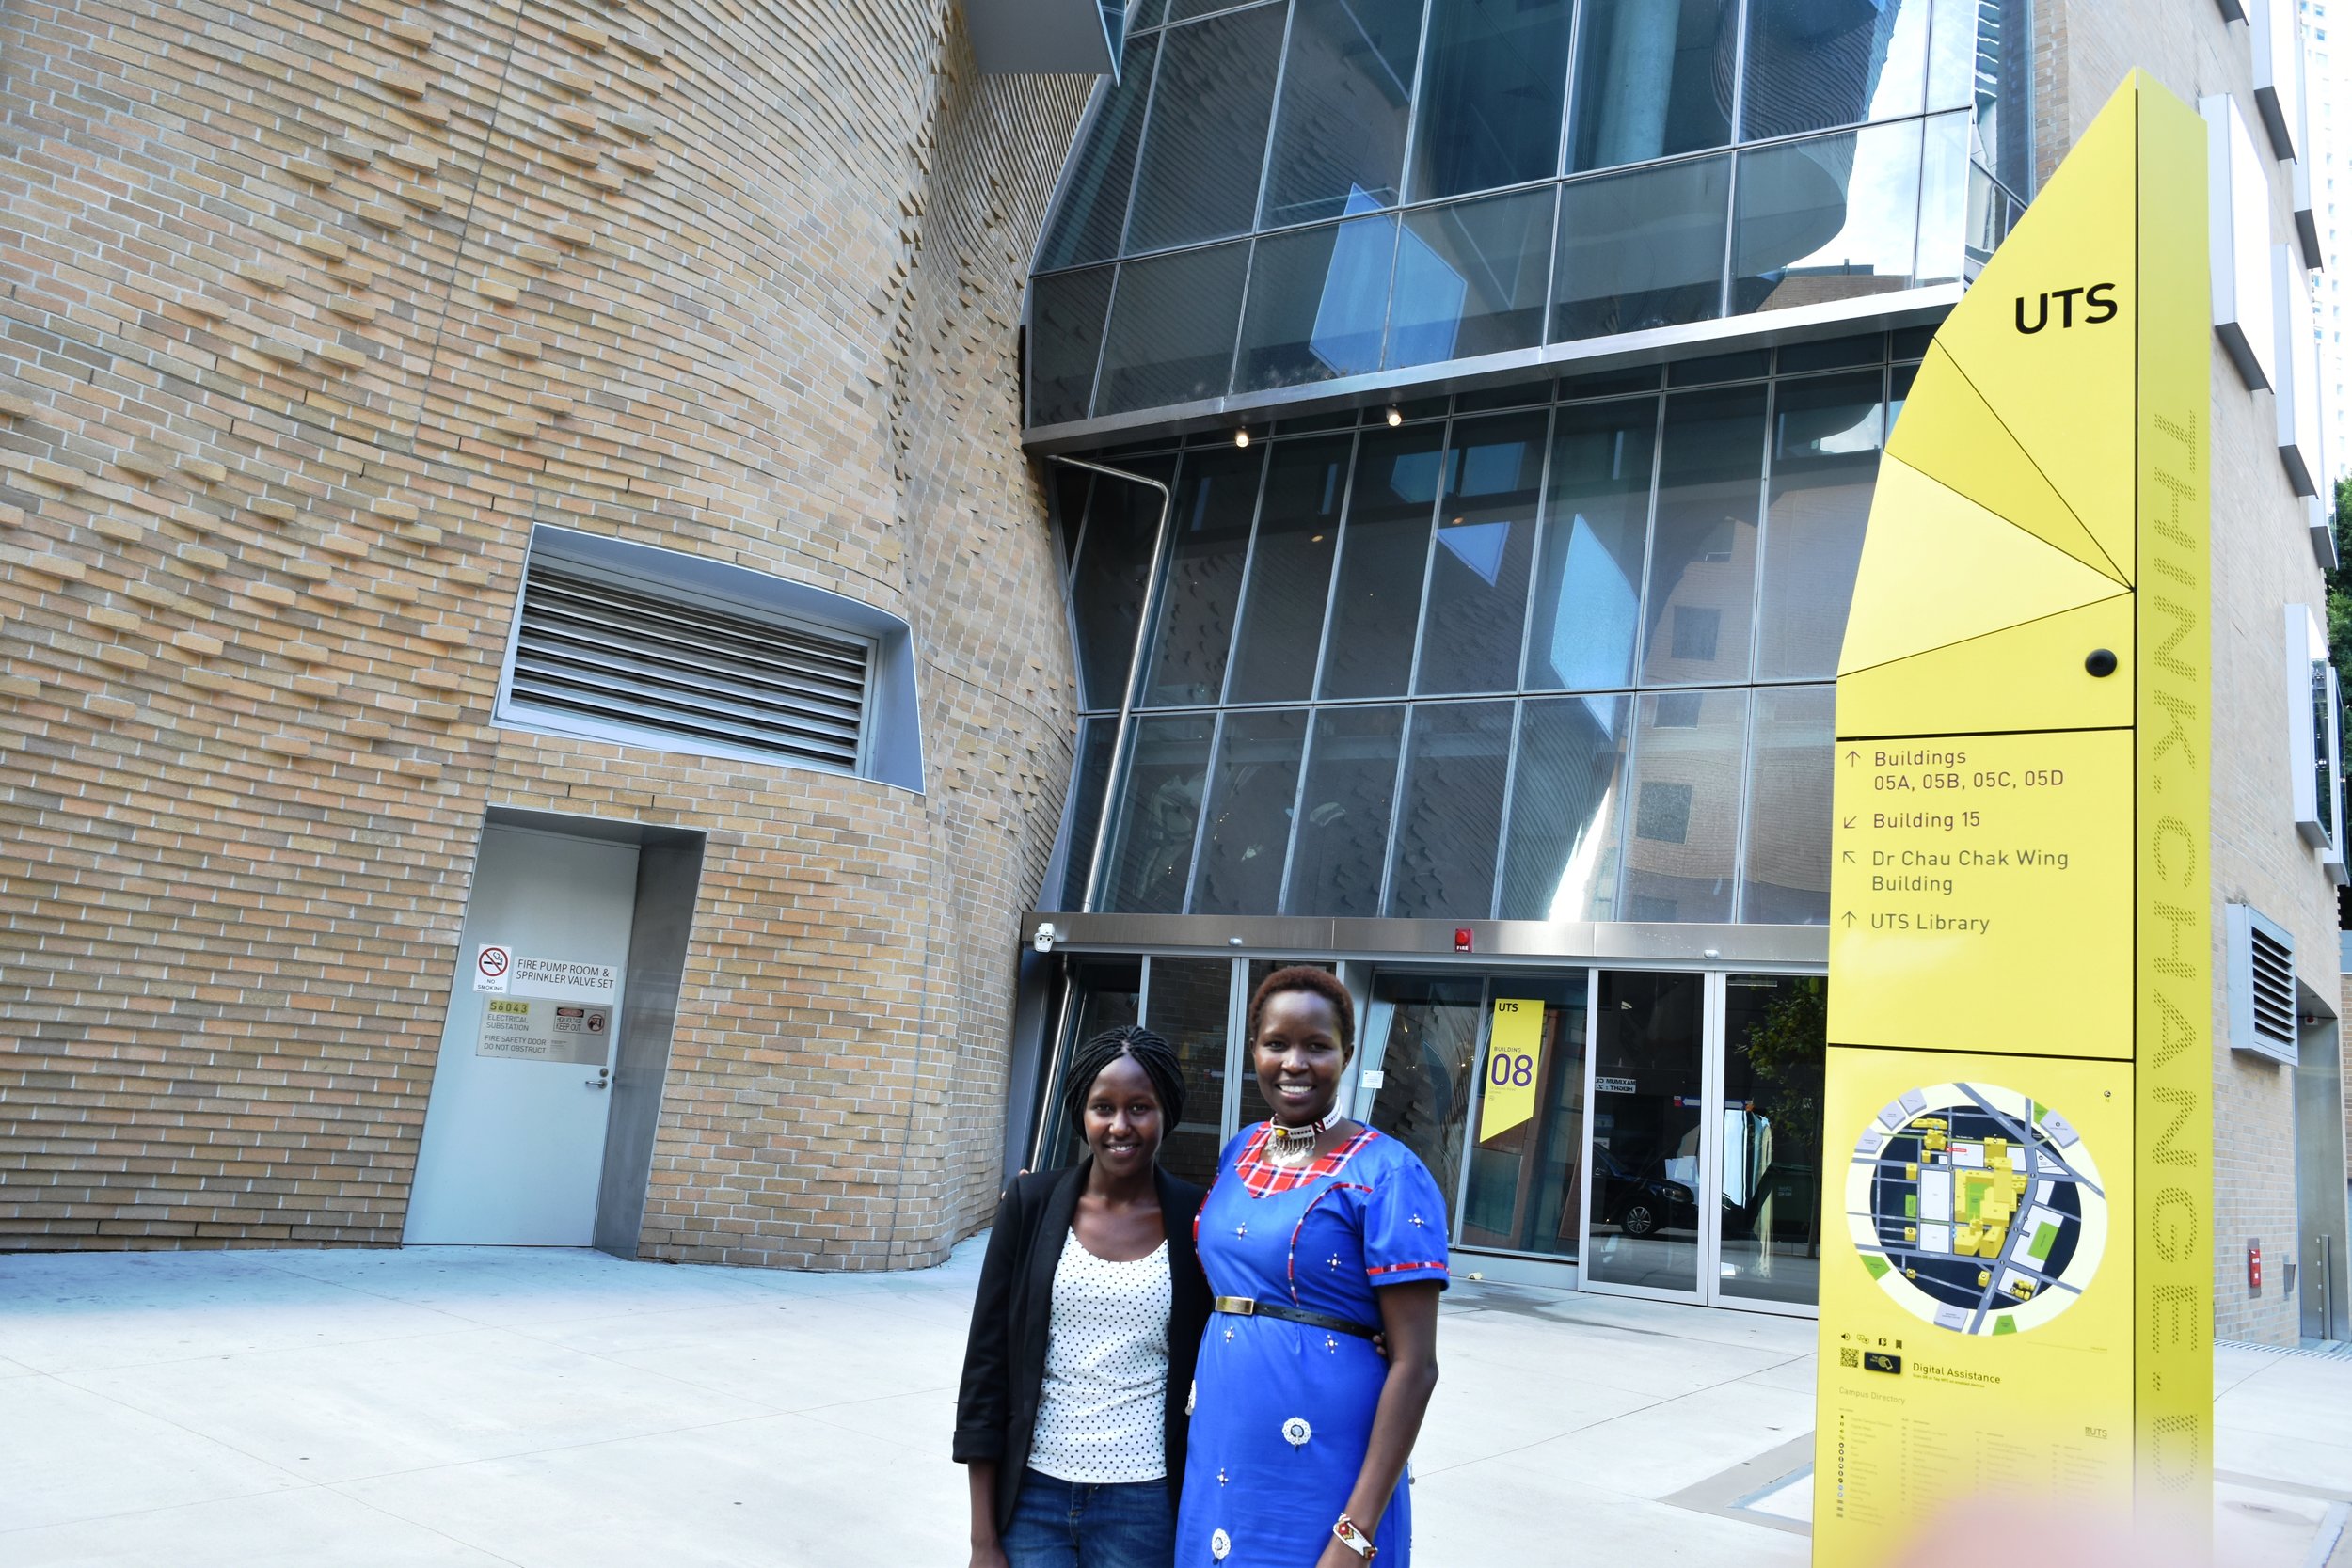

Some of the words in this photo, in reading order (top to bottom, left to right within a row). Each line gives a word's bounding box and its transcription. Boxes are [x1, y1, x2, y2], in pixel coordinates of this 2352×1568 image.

[2015, 282, 2118, 335] UTS
[1874, 750, 1967, 768] Buildings
[1874, 774, 1915, 791] 05A,
[1922, 773, 1965, 791] 05B,
[1973, 771, 2016, 789] 05C,
[2025, 769, 2064, 786] 05D
[1873, 812, 1954, 832] Building
[1962, 811, 1980, 827] 15
[1872, 850, 1895, 866] Dr
[1901, 850, 1950, 866] Chau
[1958, 849, 2009, 866] Chak
[2017, 849, 2069, 870] Wing
[1871, 875, 1953, 895] Building
[1870, 913, 1909, 929] UTS
[1917, 913, 1990, 935] Library
[517, 959, 538, 970] FIRE
[540, 961, 568, 973] PUMP
[570, 965, 599, 976] ROOM
[602, 968, 609, 977] &
[516, 970, 566, 984] SPRINKLER
[568, 976, 596, 987] VALVE
[597, 979, 614, 988] SET
[490, 1001, 528, 1013] S6043
[1498, 1003, 1518, 1012] UTS
[486, 1022, 529, 1031] SUBSTATION
[488, 1014, 528, 1023] ELECTRICAL
[510, 1045, 546, 1054] OBSTRUCT
[1491, 1053, 1533, 1087] 08
[1913, 1362, 1944, 1375] Digital
[1947, 1368, 2001, 1384] Assistance
[1839, 1386, 1869, 1399] Campus
[1871, 1392, 1906, 1405] Directory
[2090, 1427, 2108, 1438] UTS
